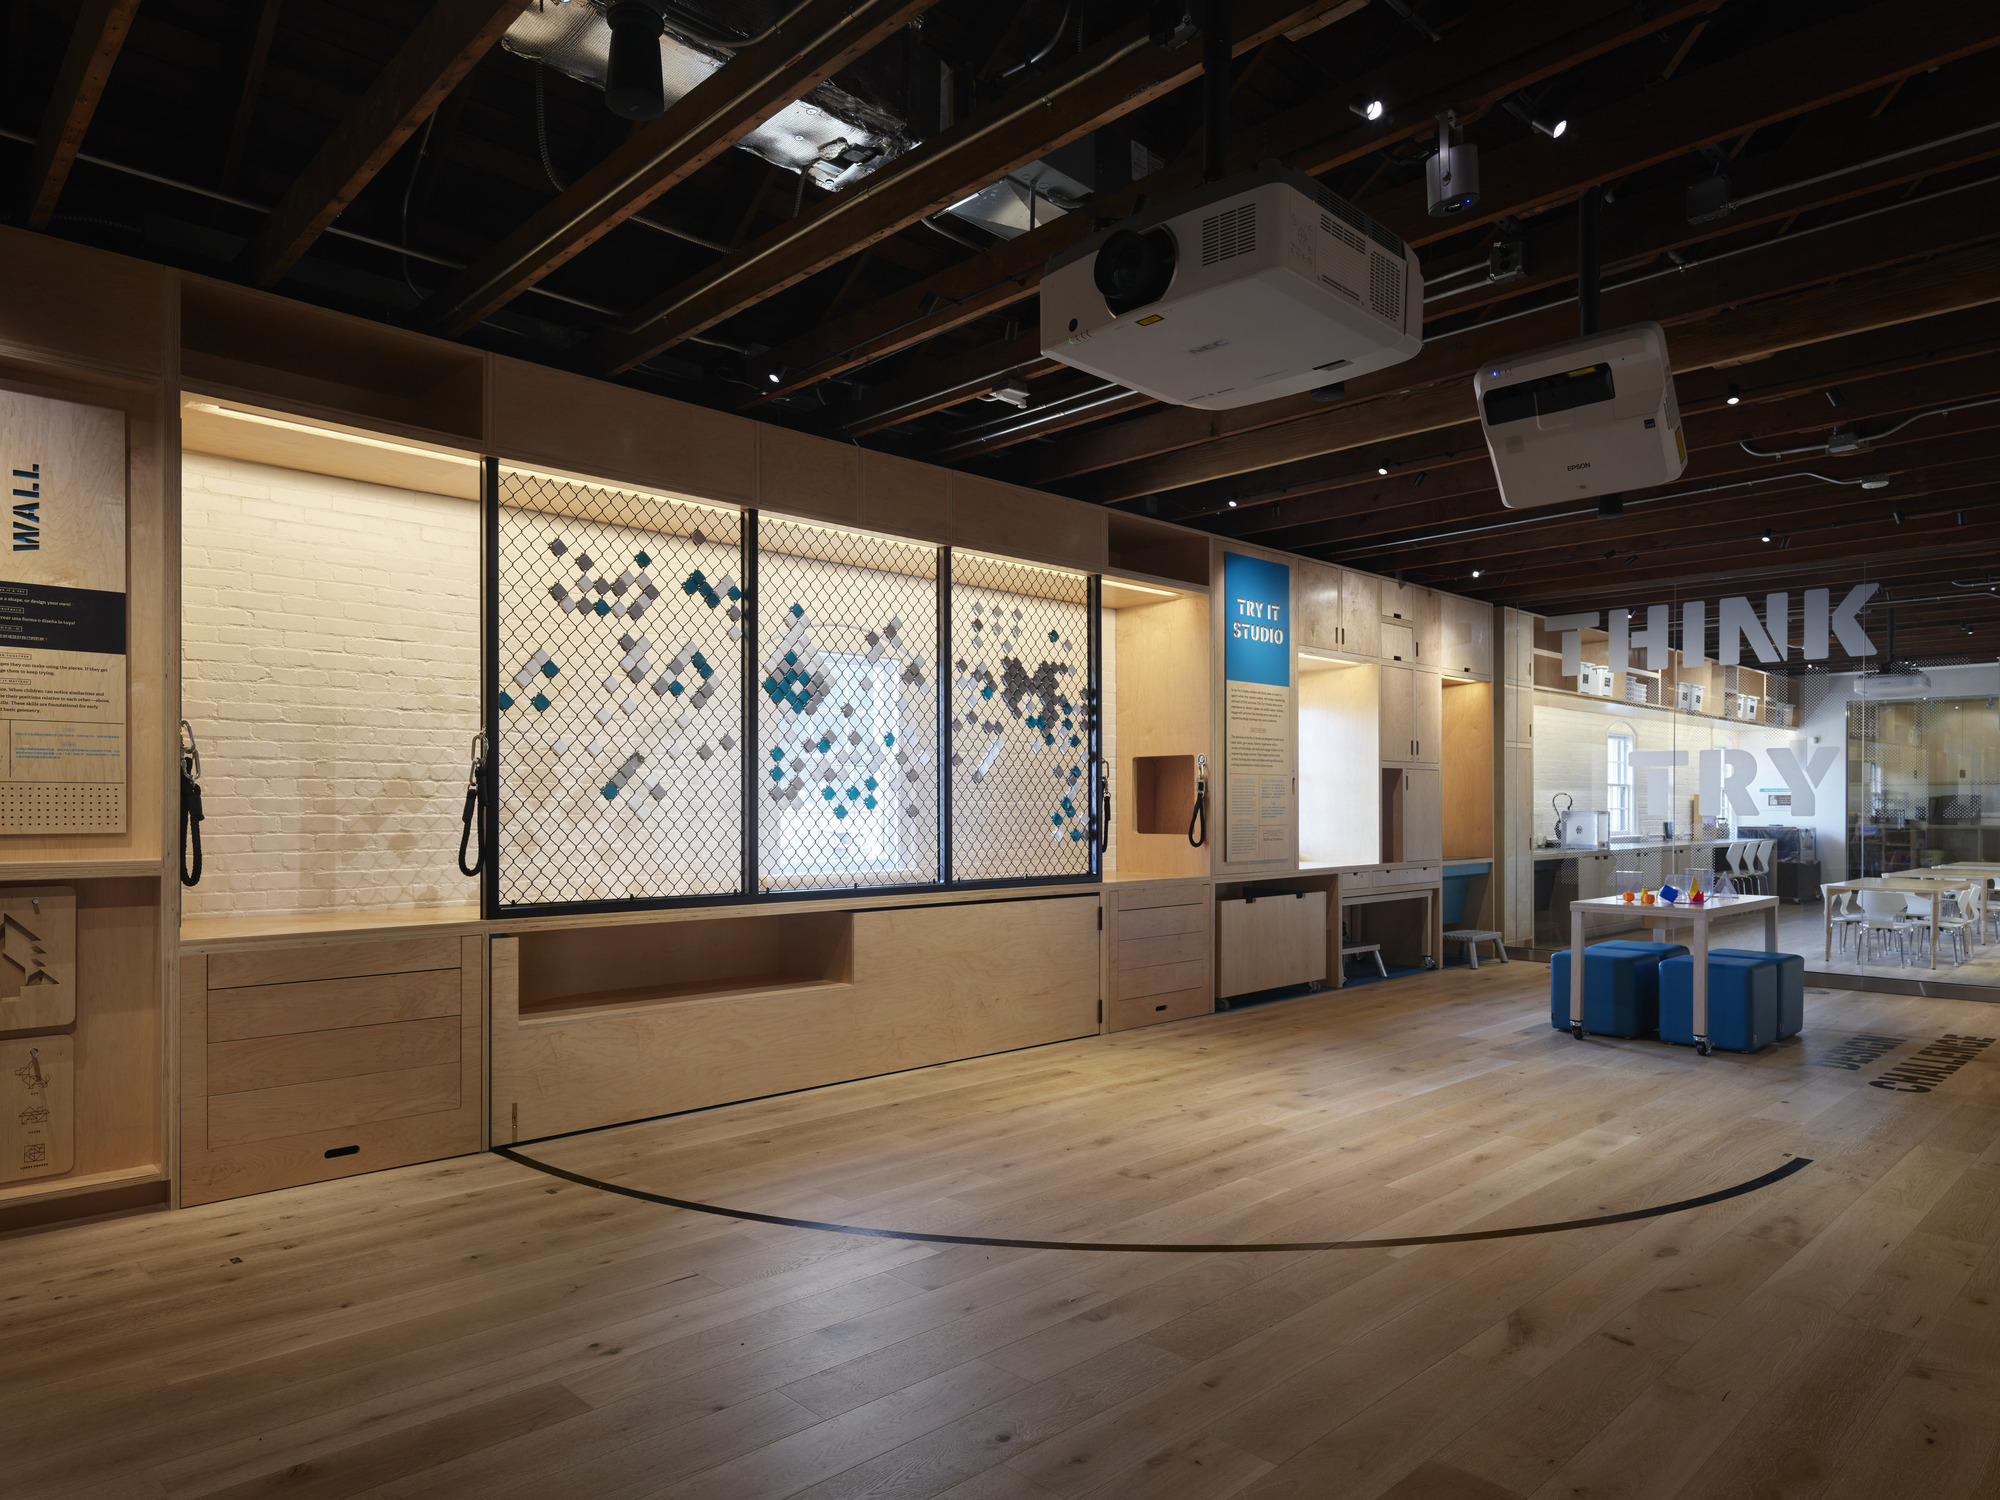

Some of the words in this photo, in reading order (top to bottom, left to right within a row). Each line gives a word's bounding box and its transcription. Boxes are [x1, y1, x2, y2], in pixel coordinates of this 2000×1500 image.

[1567, 462, 1591, 471] EPSON
[13, 463, 40, 552] WALL
[1233, 621, 1284, 645] STUDIO
[1237, 597, 1264, 618] TRY
[1267, 603, 1280, 621] IT
[1544, 583, 1881, 677] THINK
[1629, 746, 1841, 817] TRY
[1806, 1033, 1908, 1071] DESIGN
[1869, 1034, 1997, 1094] CHALLENGE
